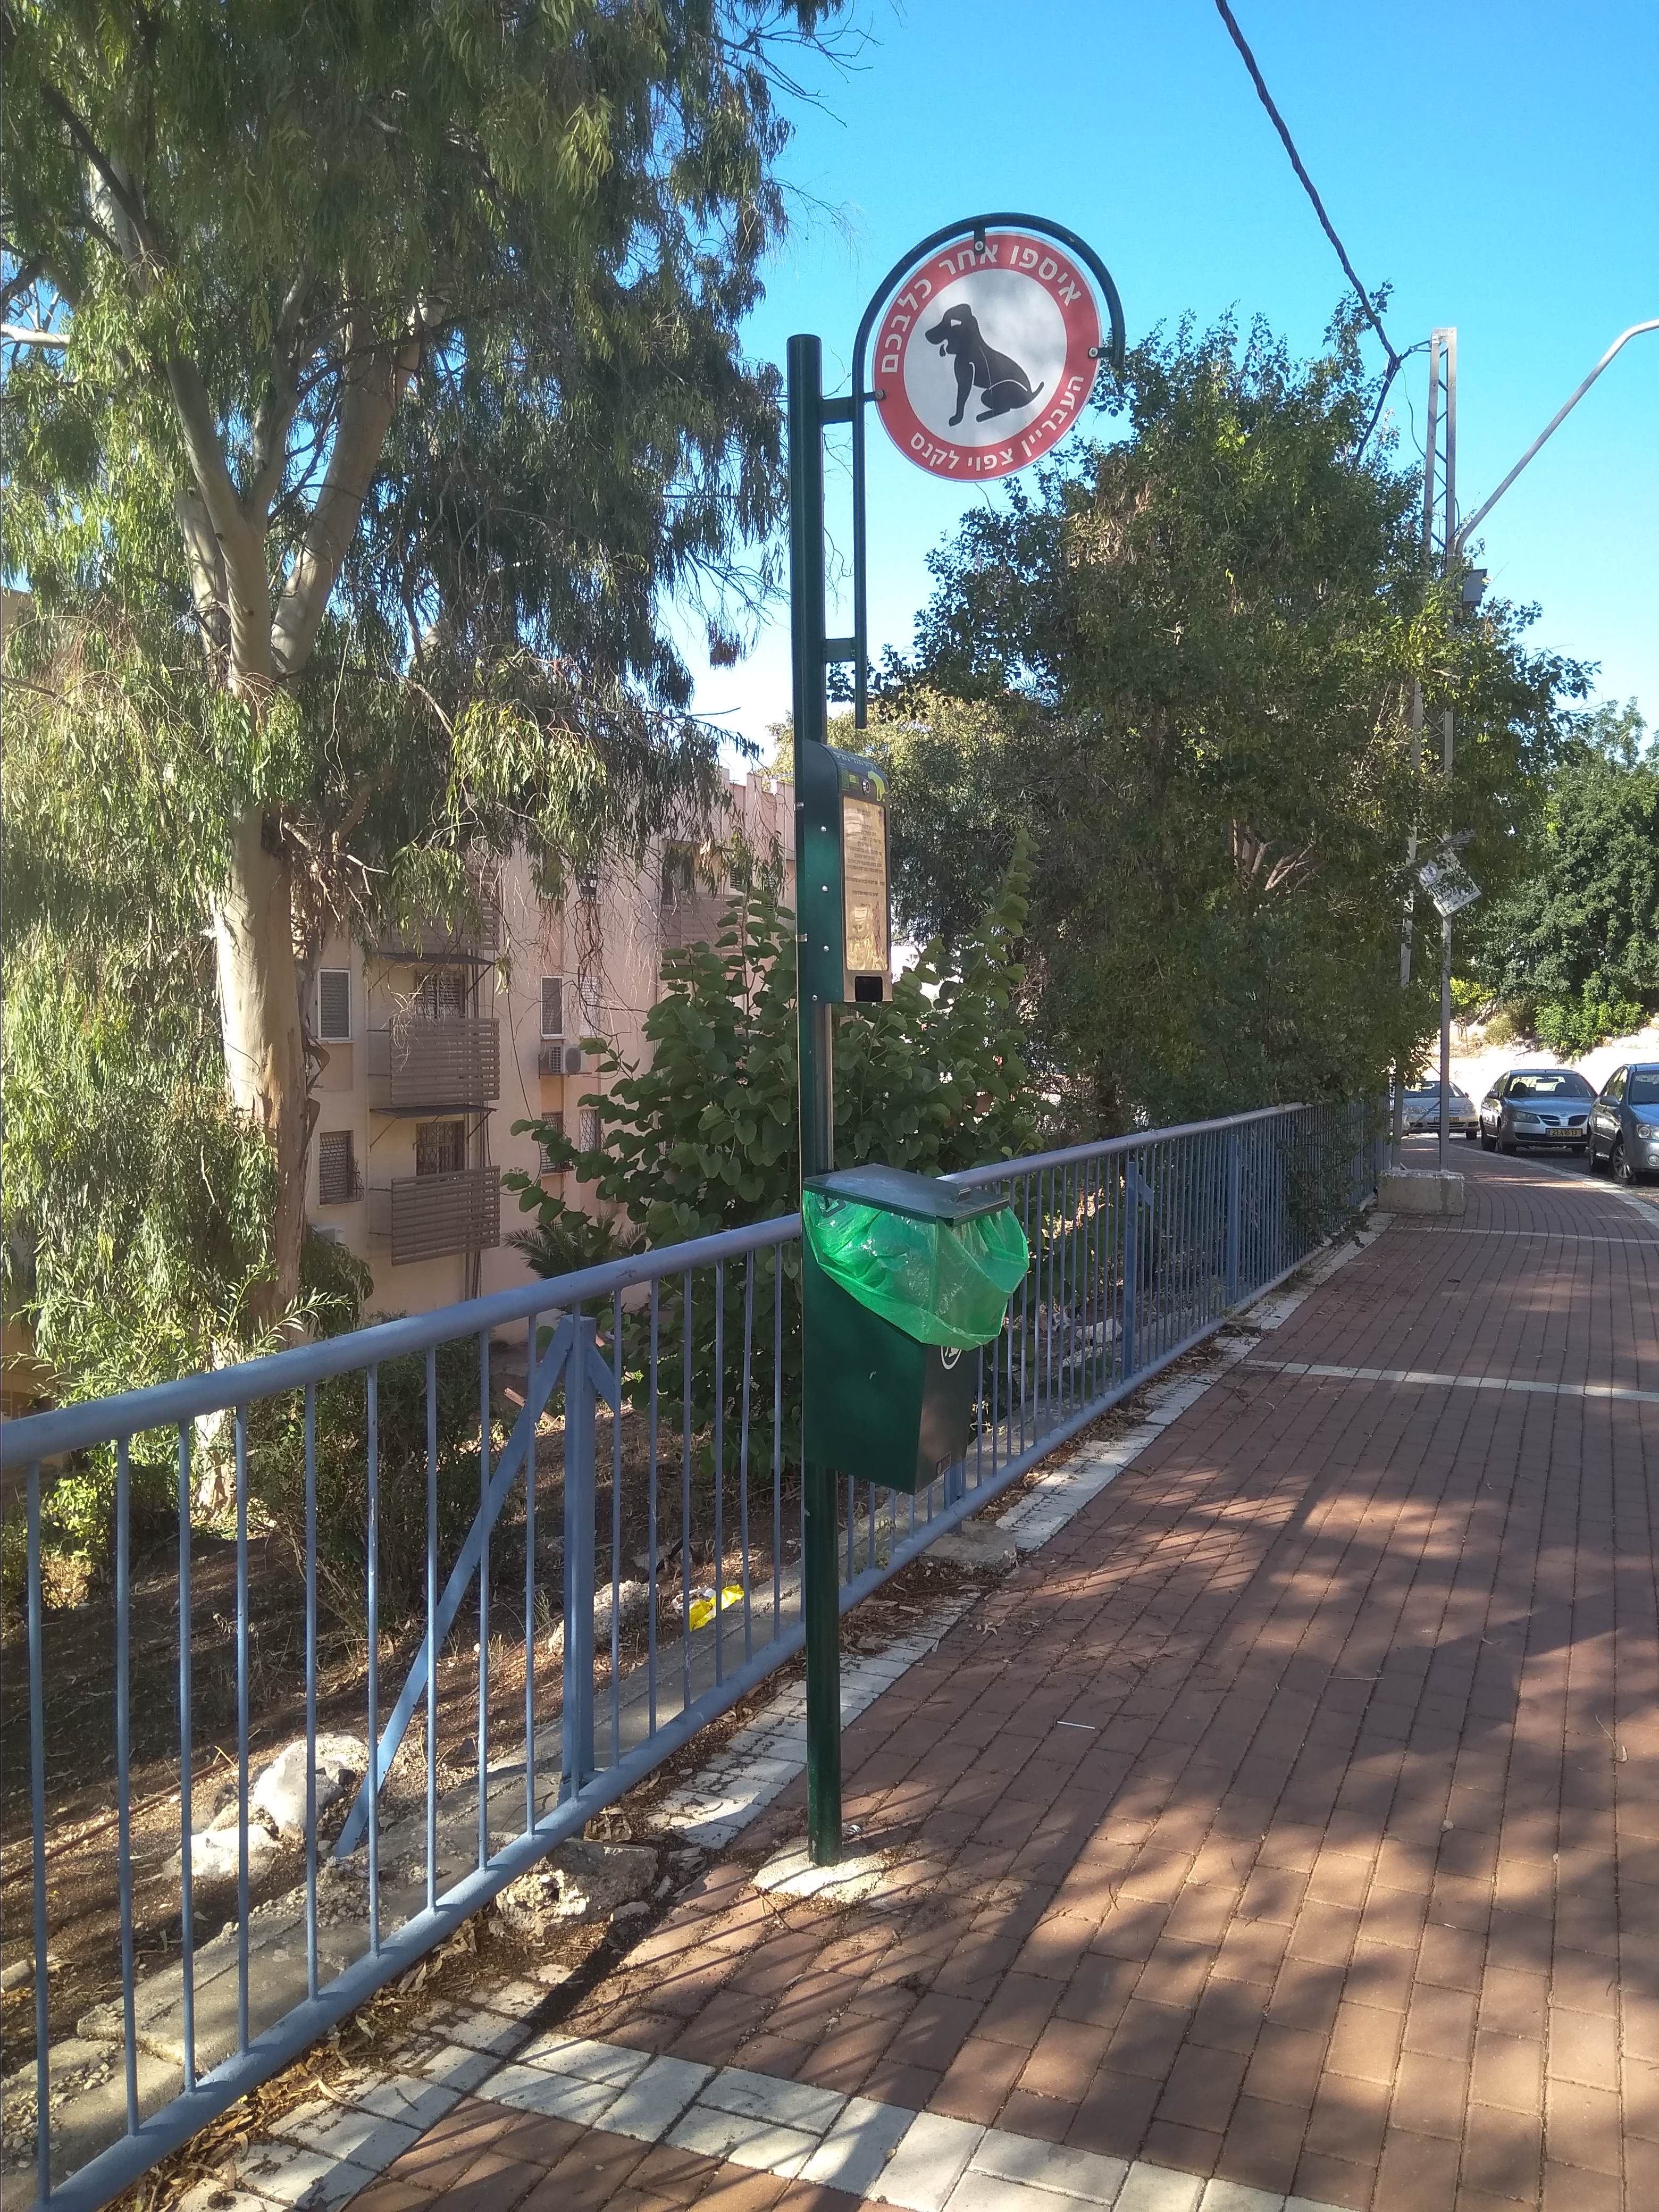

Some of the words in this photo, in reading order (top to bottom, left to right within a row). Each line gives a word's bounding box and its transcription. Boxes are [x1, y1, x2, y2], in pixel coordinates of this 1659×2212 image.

[939, 244, 998, 275] אחר
[1010, 245, 1082, 307] אוספו
[881, 278, 933, 373] כלבכם
[1021, 375, 1084, 457] העבריין
[910, 432, 960, 470] לקנס
[968, 448, 1015, 471] צפוי
[1436, 894, 1453, 904] Danger
